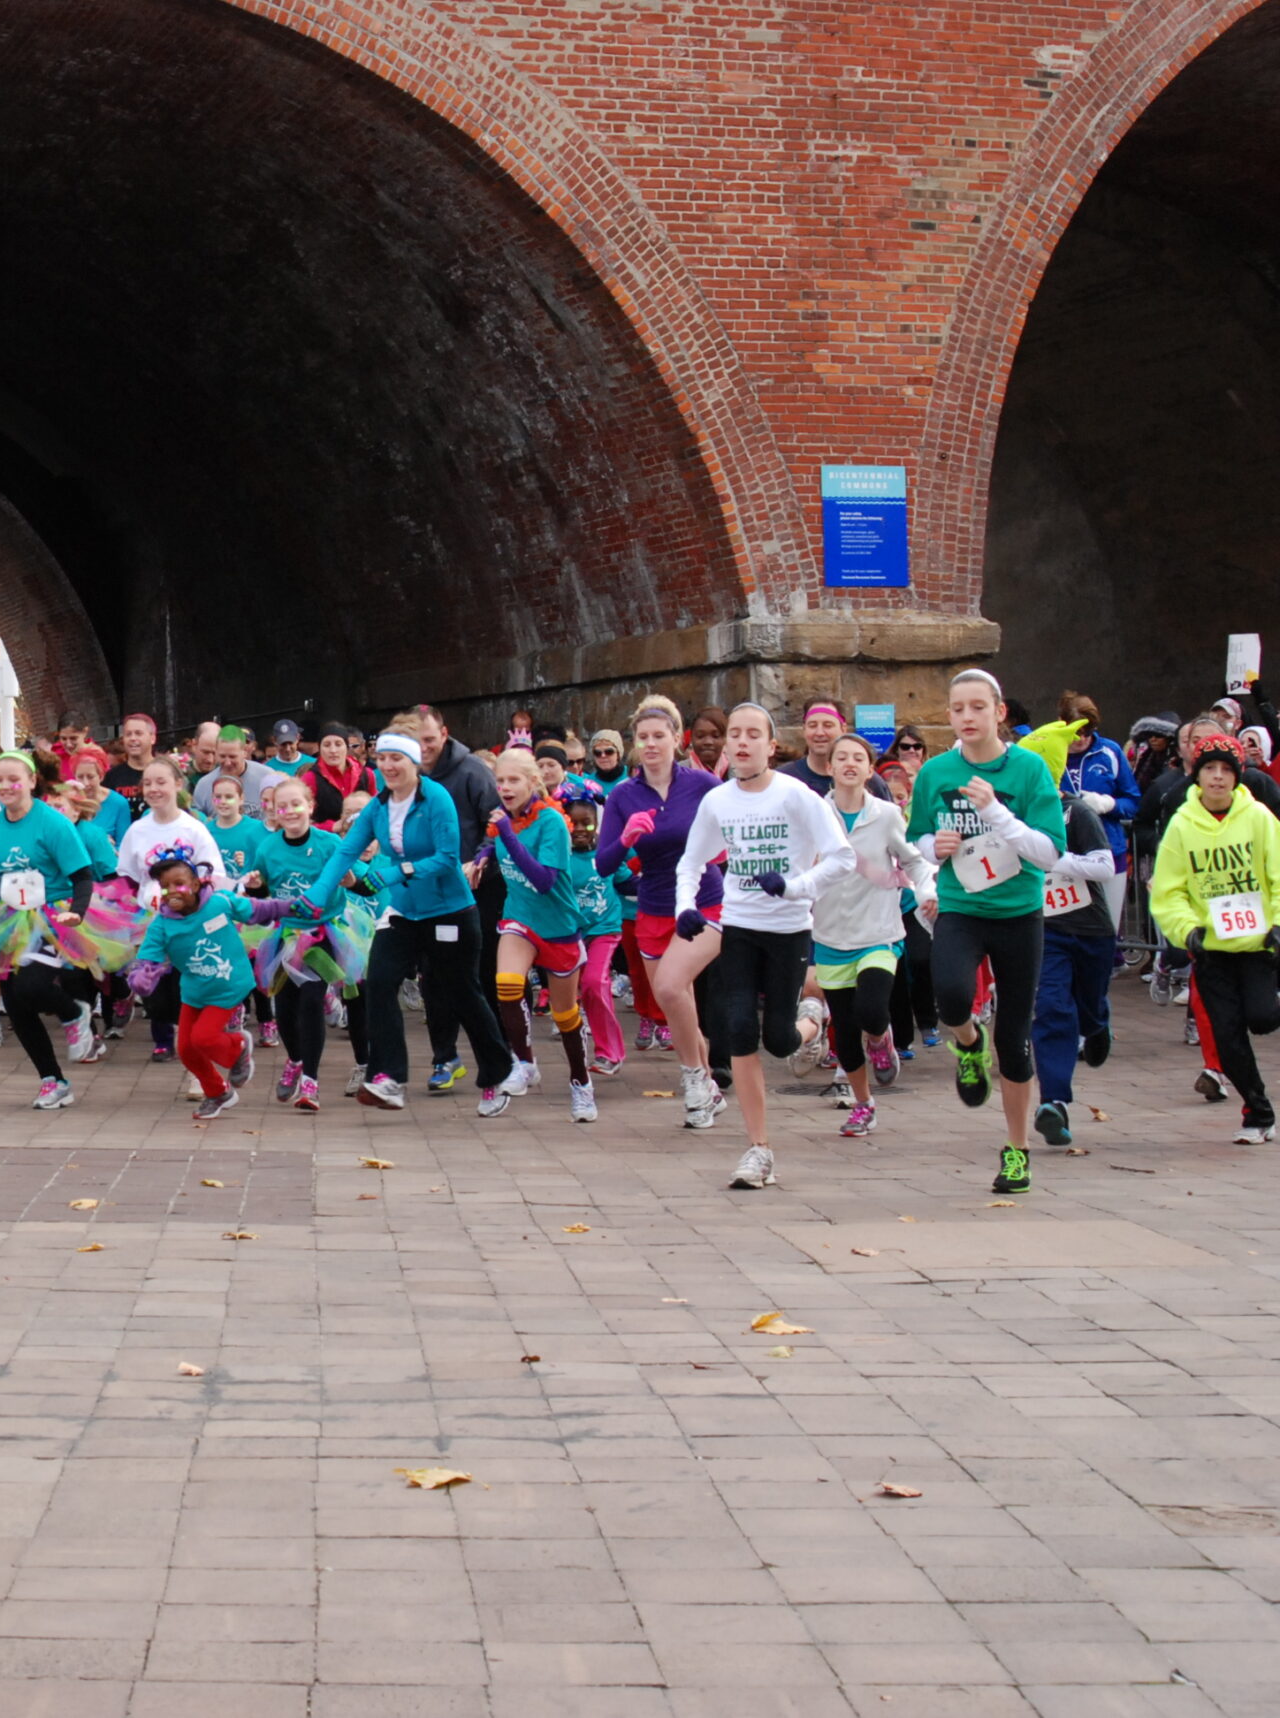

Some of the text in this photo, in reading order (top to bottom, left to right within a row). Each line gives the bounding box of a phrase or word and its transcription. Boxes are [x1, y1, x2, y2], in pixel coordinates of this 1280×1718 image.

[840, 481, 889, 490] COMMONS
[937, 810, 982, 826] HARRI
[741, 824, 789, 841] LEAGUE
[1189, 841, 1254, 874] LIONS
[979, 856, 997, 881] 1
[19, 888, 26, 905] 1
[1045, 885, 1081, 910] 431
[1221, 909, 1258, 932] 569
